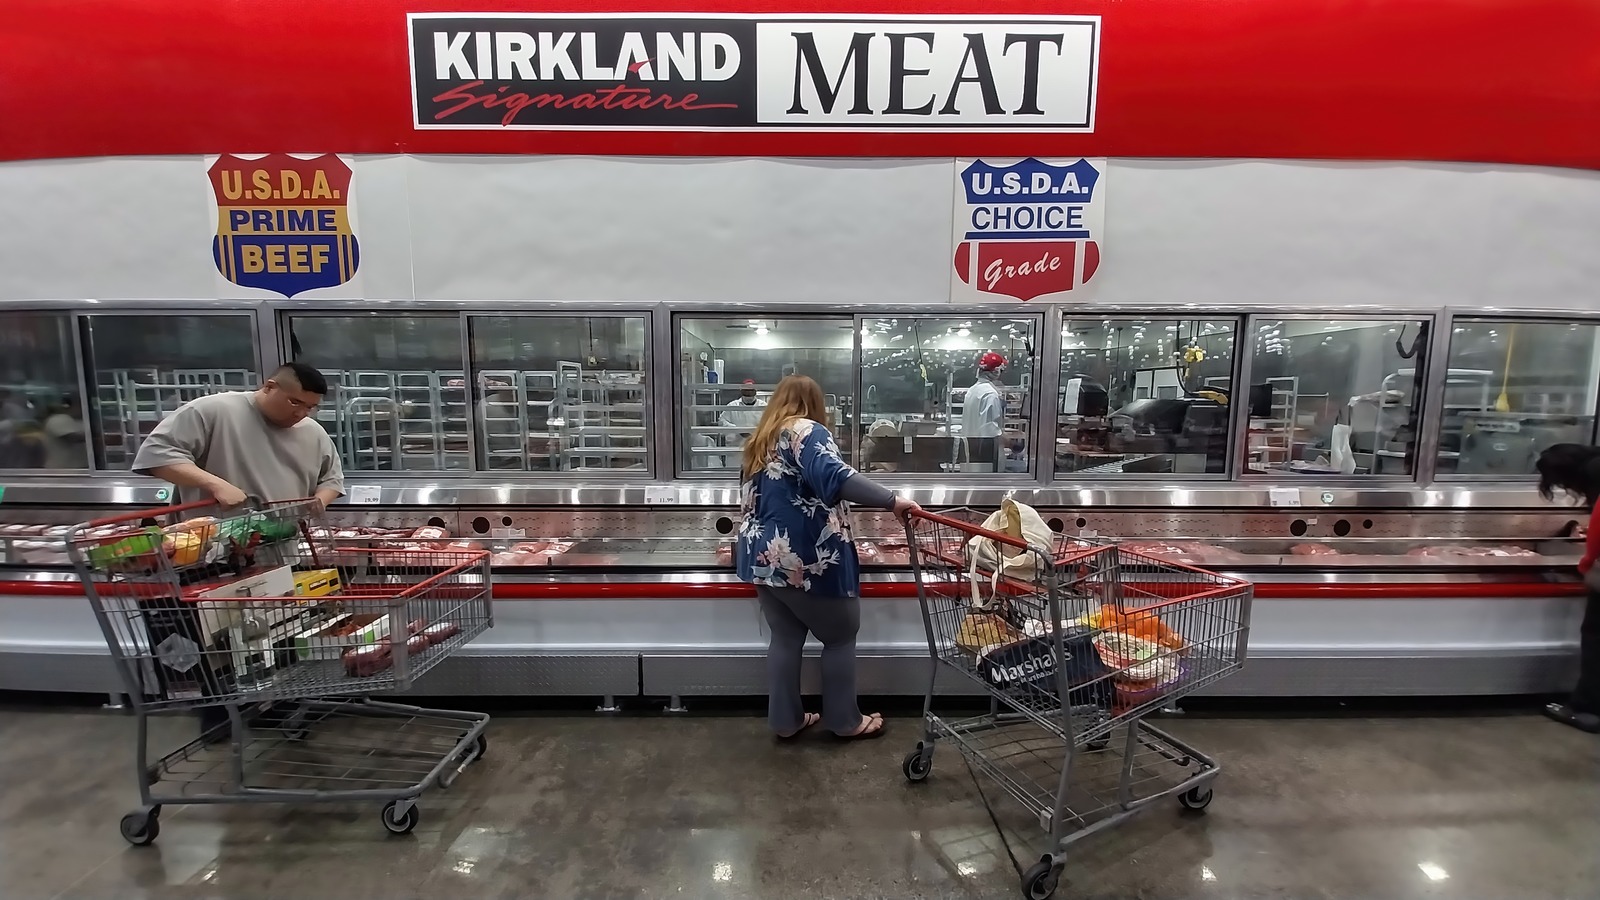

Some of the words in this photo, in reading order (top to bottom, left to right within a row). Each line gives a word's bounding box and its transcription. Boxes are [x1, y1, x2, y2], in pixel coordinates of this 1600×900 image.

[433, 31, 741, 81] KIRKLAND
[785, 31, 1065, 116] MEAT
[432, 80, 738, 127] Signature
[221, 169, 341, 200] U.S.D.A.
[971, 172, 1089, 196] U.S.D.A.
[229, 209, 338, 232] PRIME
[971, 206, 1084, 230] CHOICE
[240, 244, 330, 273] BEEF
[983, 251, 1062, 290] Grade
